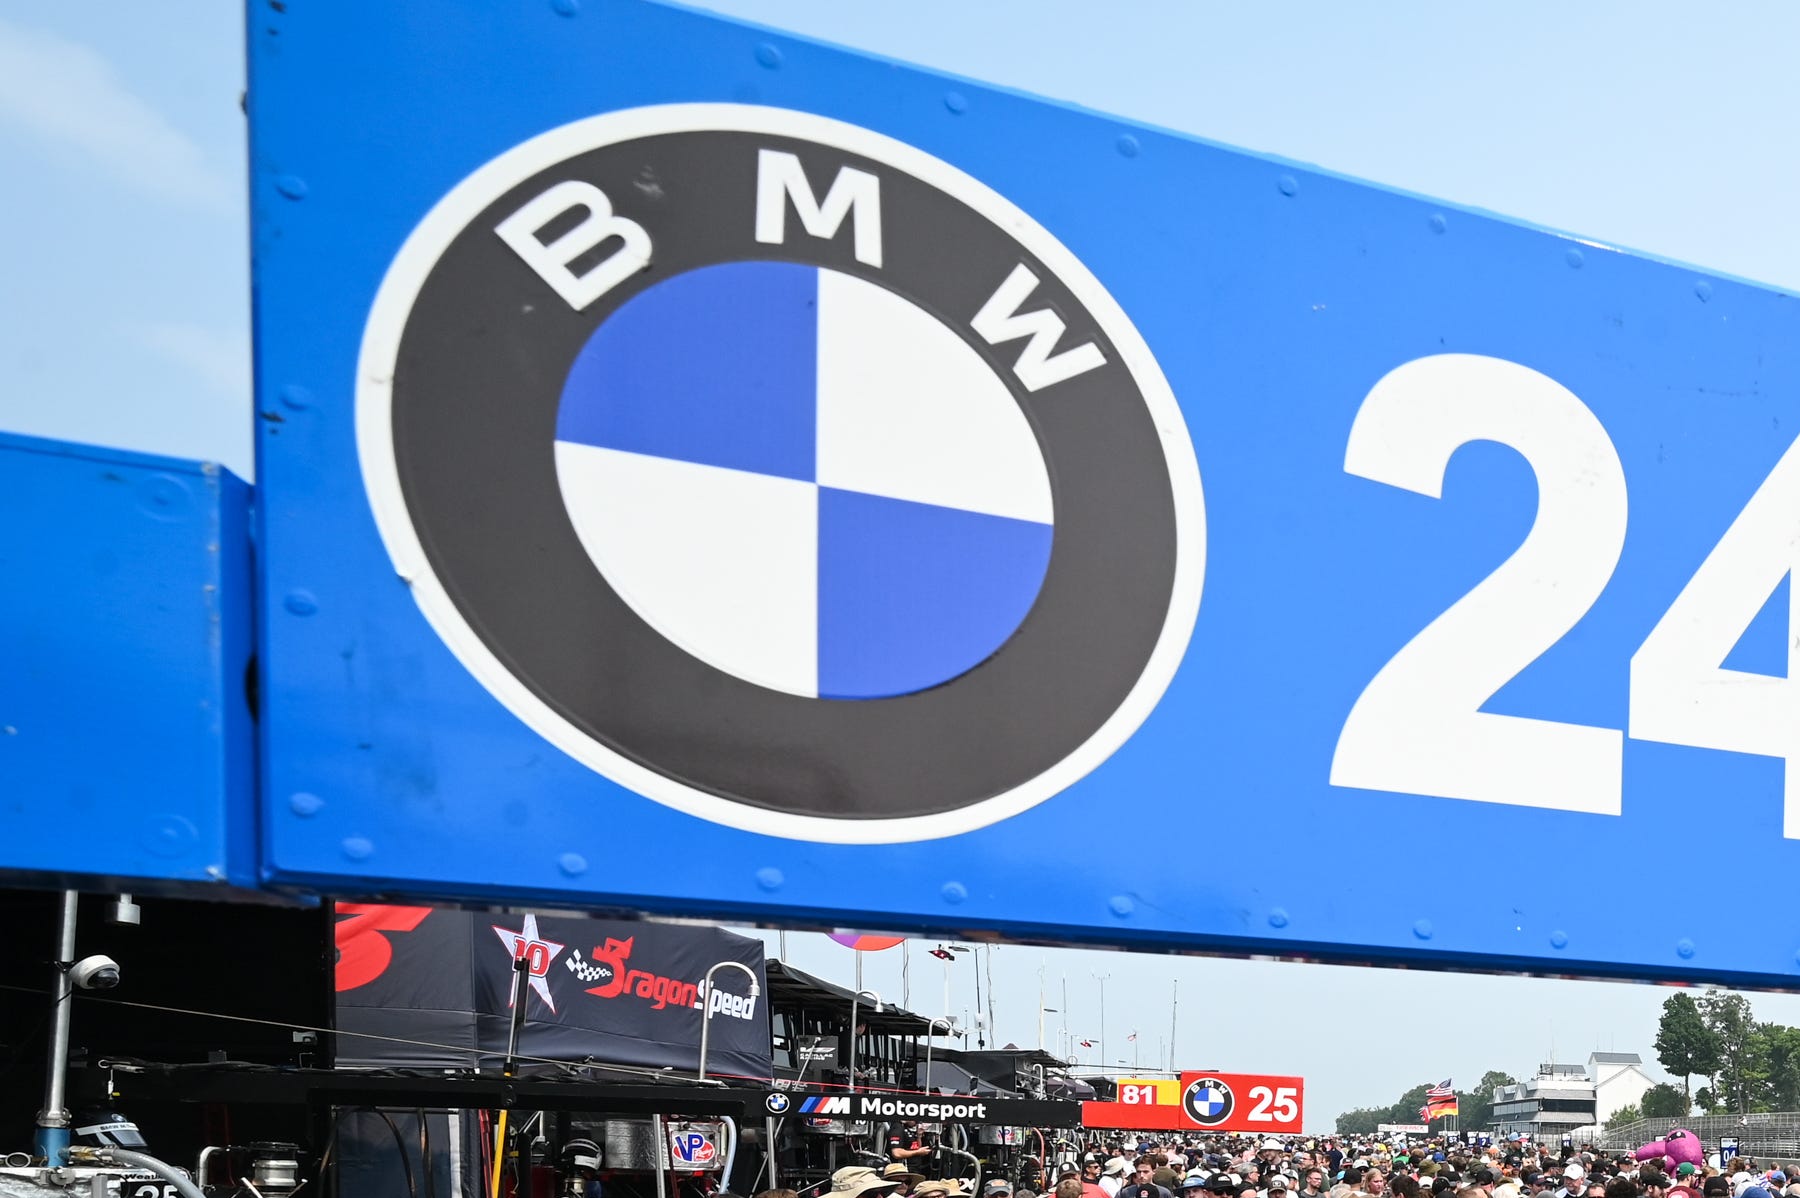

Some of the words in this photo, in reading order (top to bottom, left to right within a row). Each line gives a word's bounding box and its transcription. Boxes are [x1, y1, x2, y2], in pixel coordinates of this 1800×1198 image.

[494, 148, 1108, 395] BMW
[1122, 1085, 1154, 1105] 81
[1191, 1079, 1229, 1094] BMW
[860, 1098, 986, 1120] Motorsport
[1247, 1086, 1298, 1124] 25
[675, 1133, 705, 1162] VP
